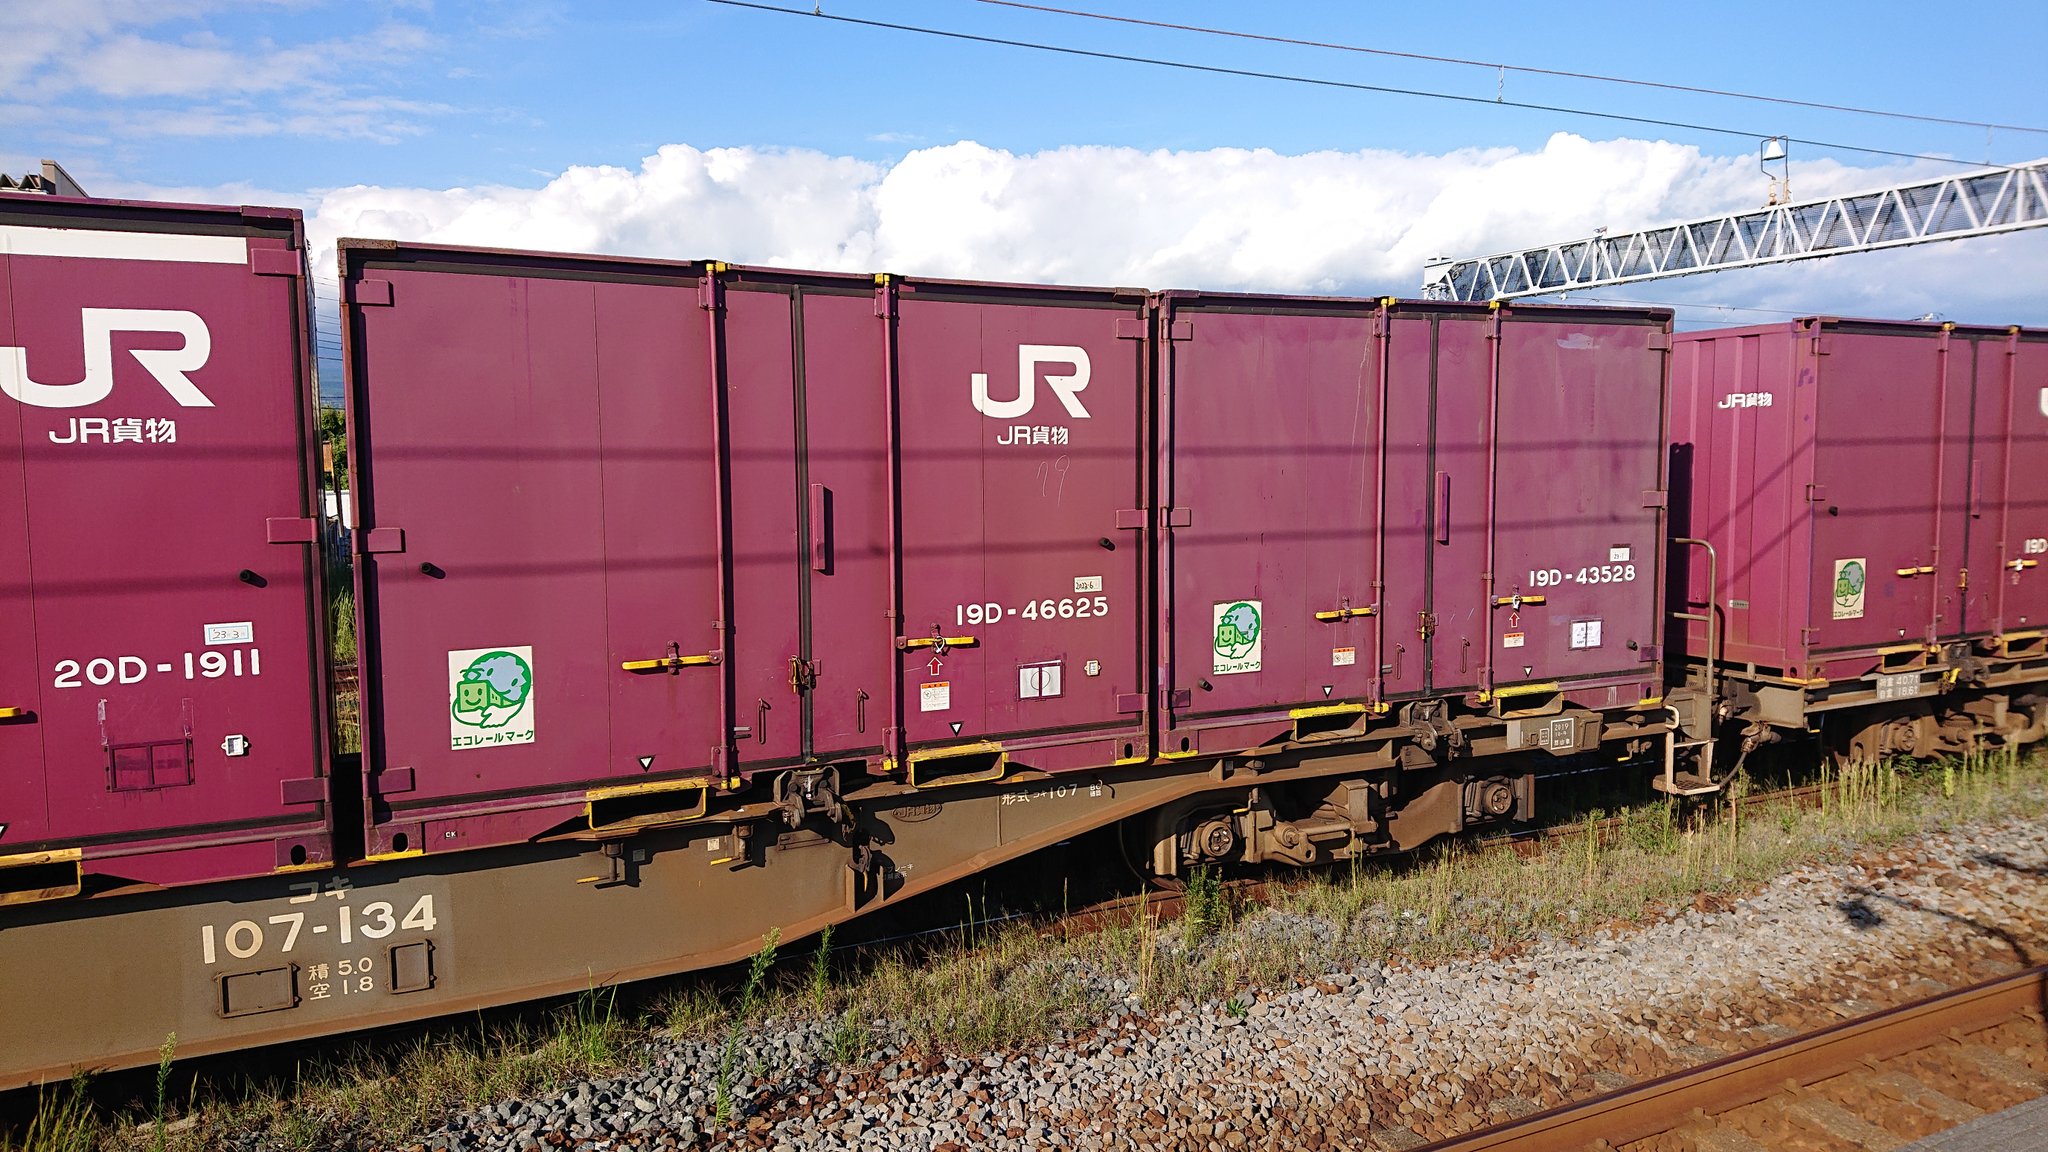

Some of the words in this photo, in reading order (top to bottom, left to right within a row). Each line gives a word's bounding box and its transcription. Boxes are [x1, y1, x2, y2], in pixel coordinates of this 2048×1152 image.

[0, 308, 216, 408] JR
[971, 344, 1092, 419] JR
[1718, 392, 1773, 409] JR貨物
[49, 418, 177, 444] JR貨物
[997, 425, 1069, 445] JR貨物
[1529, 565, 1636, 587] 19D-43528
[956, 596, 1109, 626] 19D-46625
[1214, 661, 1261, 672] エコレールマーク
[452, 729, 534, 747] エコレールマーク
[288, 875, 353, 904] コキ
[202, 894, 438, 964] 107-134
[338, 957, 374, 976] 5.0
[309, 983, 332, 1001] 空
[343, 976, 374, 995] 1.8
